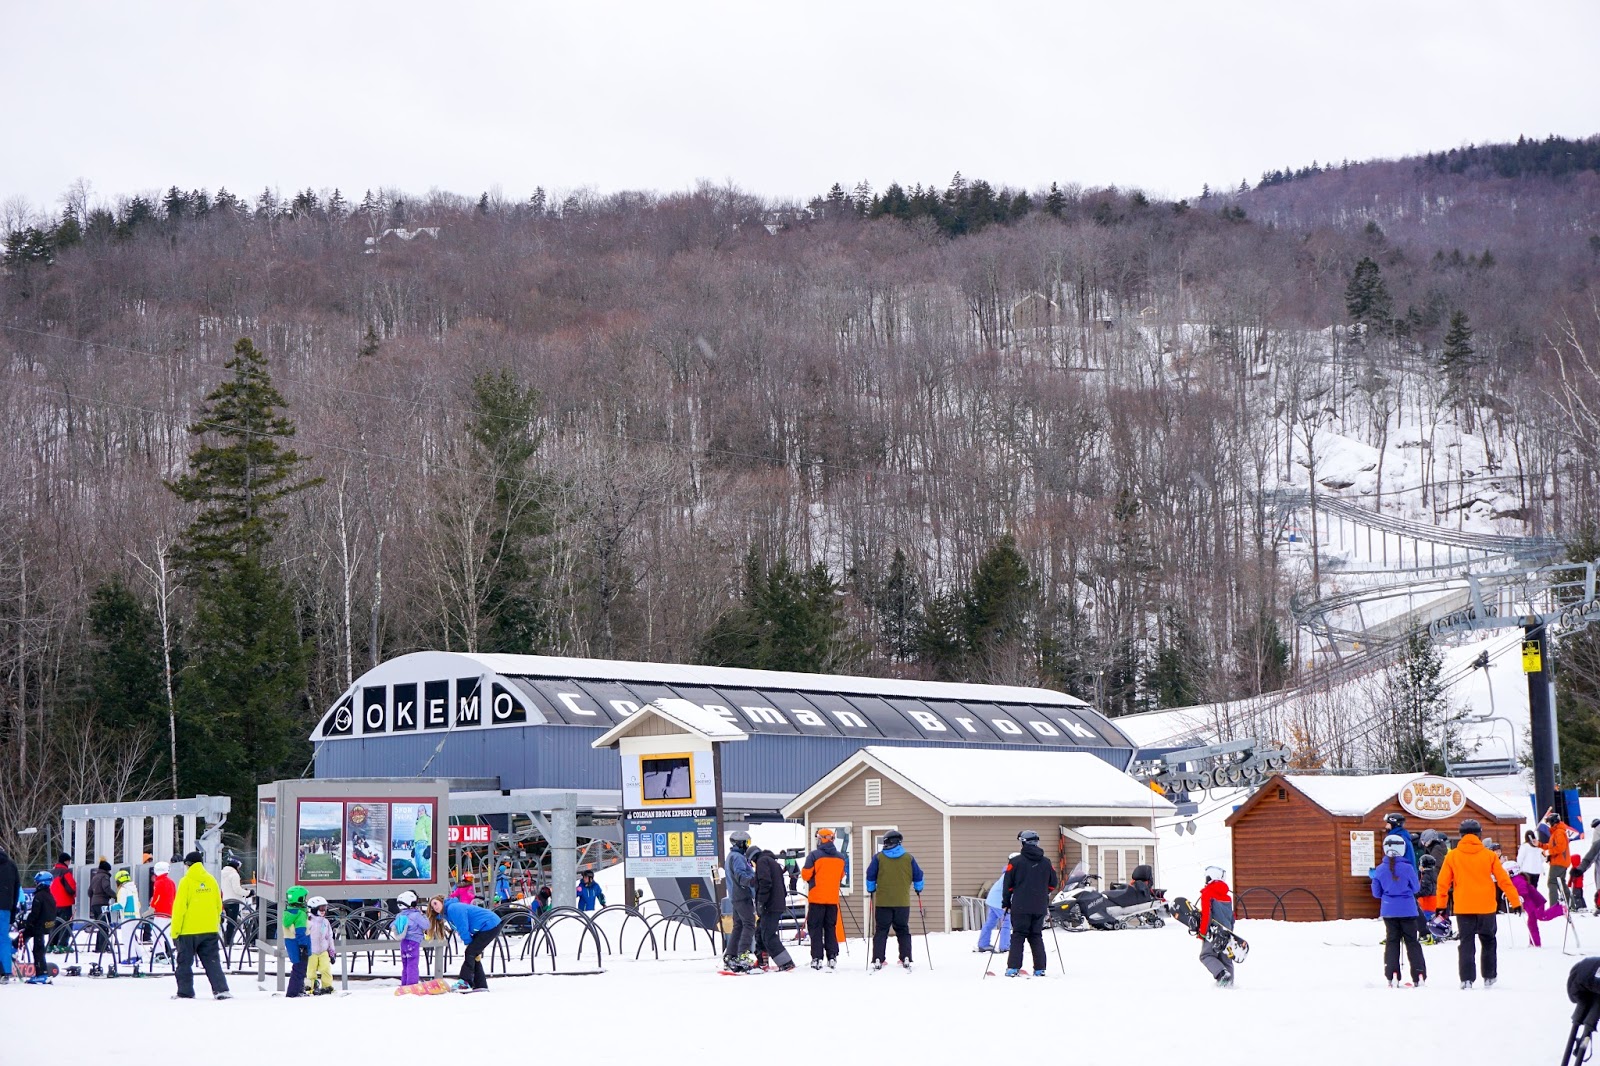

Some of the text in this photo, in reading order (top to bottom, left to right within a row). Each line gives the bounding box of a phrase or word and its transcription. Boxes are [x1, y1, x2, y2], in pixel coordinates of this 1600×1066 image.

[366, 693, 513, 729] OKEMO
[557, 692, 1097, 738] Coeman Brook
[1413, 782, 1452, 796] Waffle
[1415, 798, 1451, 811] Cabin
[656, 810, 671, 818] BROOK
[693, 809, 707, 818] QUAD
[463, 827, 488, 841] LINE
